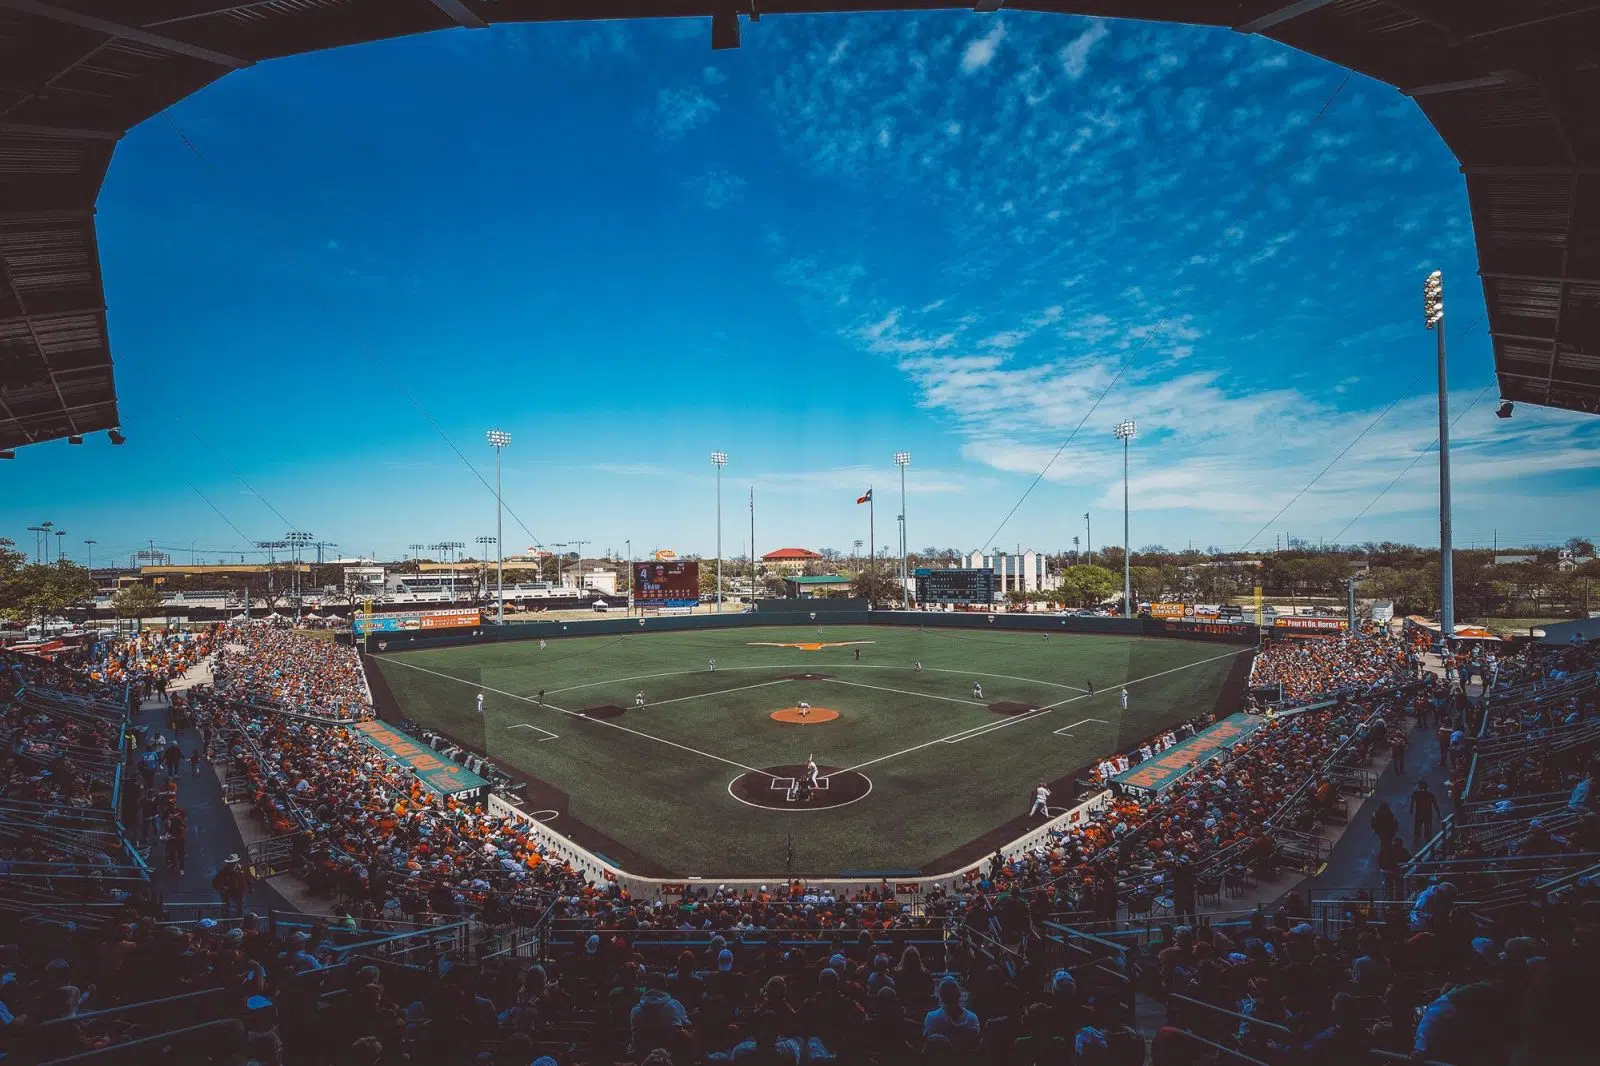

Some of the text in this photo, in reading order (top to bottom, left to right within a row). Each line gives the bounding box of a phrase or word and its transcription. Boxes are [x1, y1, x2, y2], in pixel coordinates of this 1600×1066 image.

[641, 569, 647, 579] 4
[1318, 621, 1339, 629] Horns!
[450, 787, 480, 801] YETI
